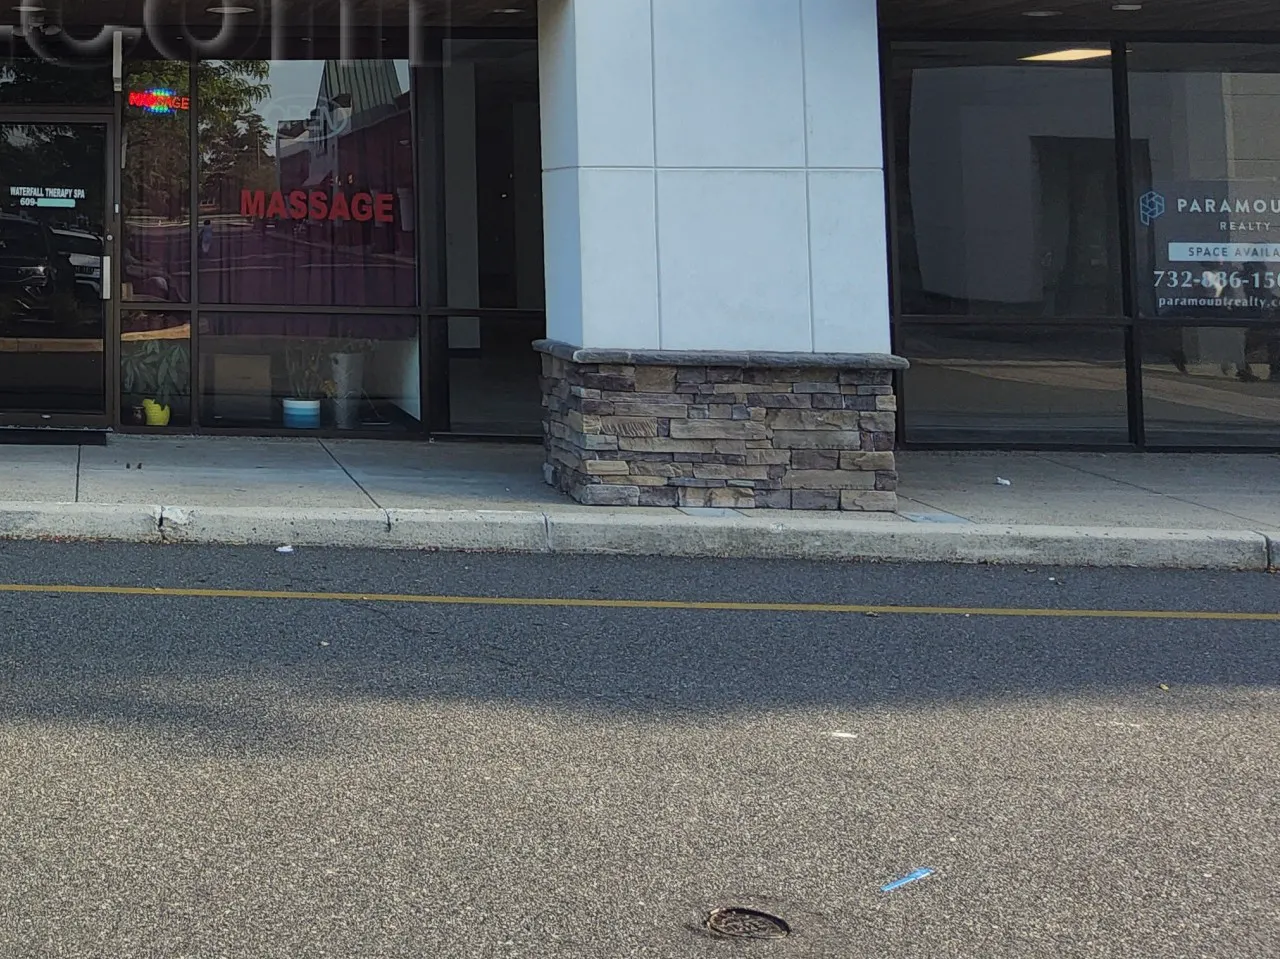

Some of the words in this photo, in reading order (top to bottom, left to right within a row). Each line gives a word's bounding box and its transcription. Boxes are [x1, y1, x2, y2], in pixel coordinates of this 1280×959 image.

[10, 186, 44, 197] WATERFALL
[45, 188, 73, 198] THERAPY
[73, 189, 85, 199] SPA
[240, 189, 393, 222] MASSAGE
[1220, 222, 1270, 231] REALTY
[1188, 247, 1228, 257] SPACE
